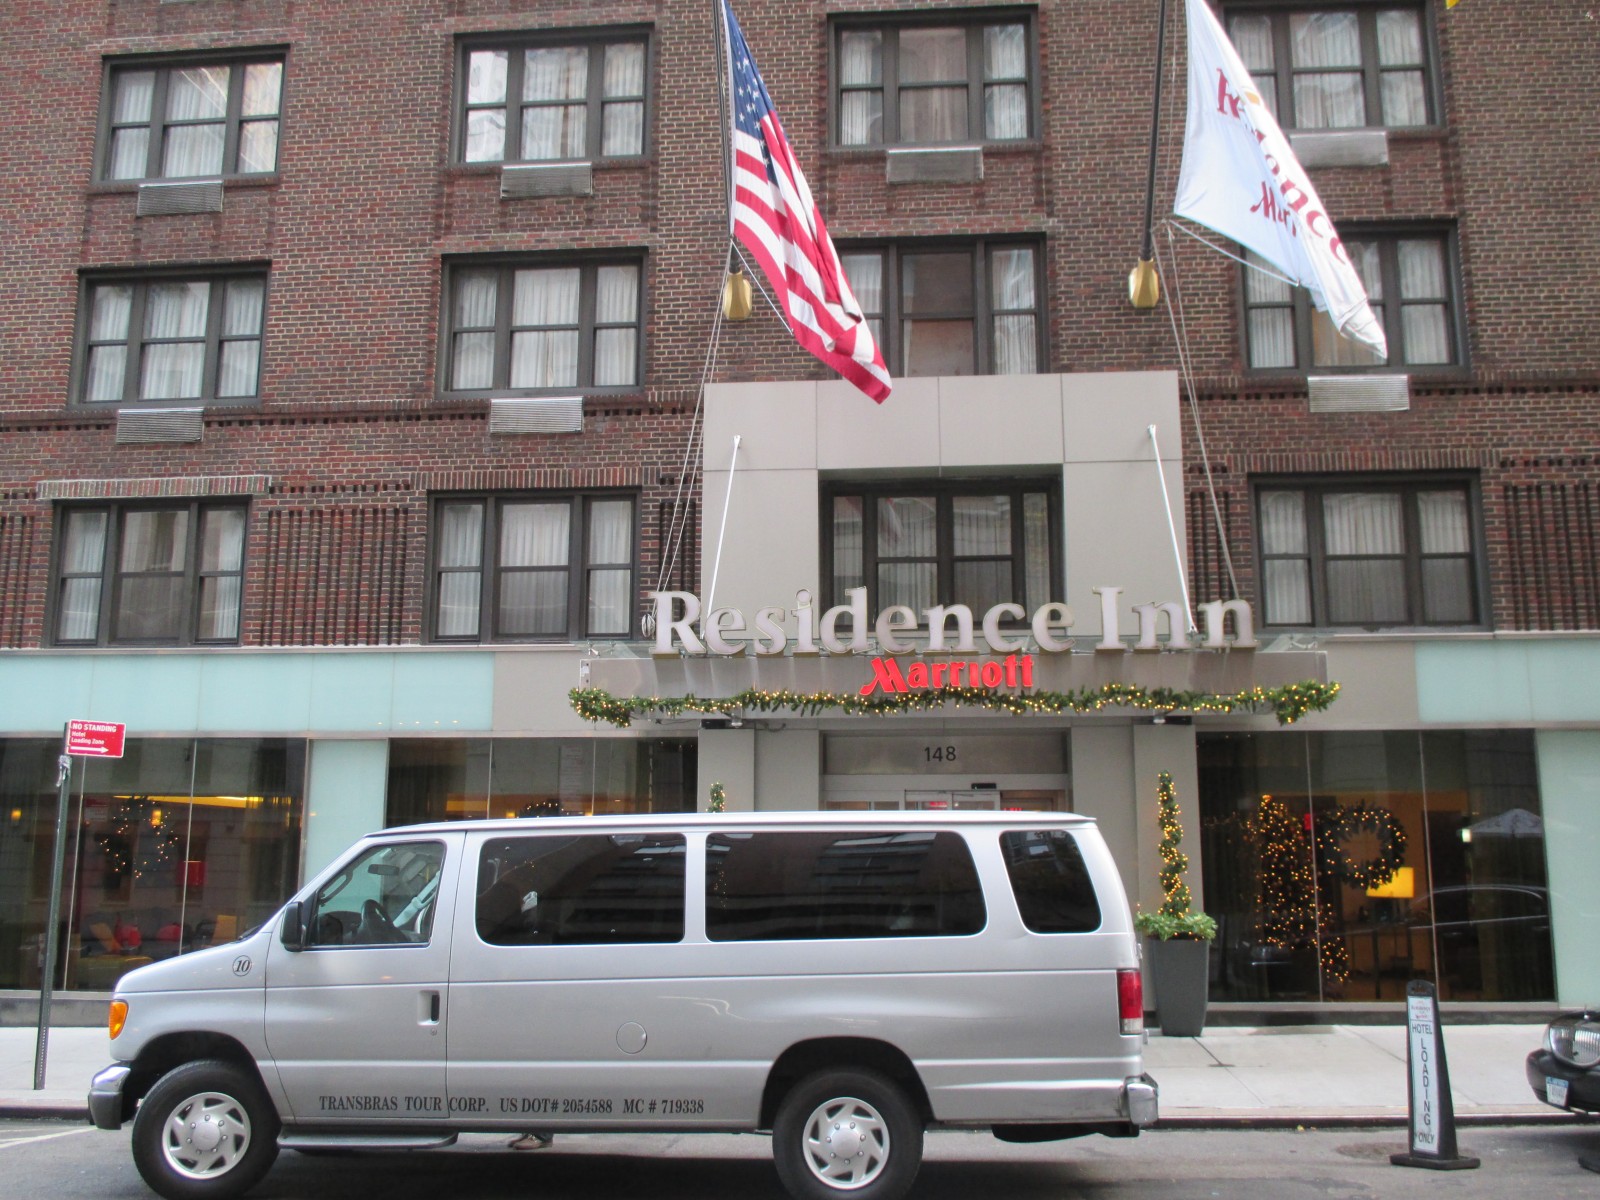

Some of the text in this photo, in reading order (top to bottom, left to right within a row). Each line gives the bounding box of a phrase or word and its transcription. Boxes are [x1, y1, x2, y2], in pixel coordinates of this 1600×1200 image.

[651, 586, 1261, 654] Residence Inn
[859, 654, 1034, 696] Marriott
[84, 724, 117, 732] STANDING
[71, 737, 91, 745] Loading
[924, 746, 957, 762] 148
[235, 959, 251, 973] 10
[1412, 1023, 1433, 1035] HOTEL
[1421, 1037, 1431, 1126] LOADING
[319, 1095, 398, 1111] TRANSBRAS
[405, 1096, 442, 1111] TOUR
[449, 1097, 490, 1112] CORP.
[500, 1097, 518, 1113] US
[563, 1099, 613, 1114] 2054588
[622, 1099, 645, 1114] MC
[661, 1099, 704, 1114] 719338
[1418, 1132, 1435, 1144] ONLY
